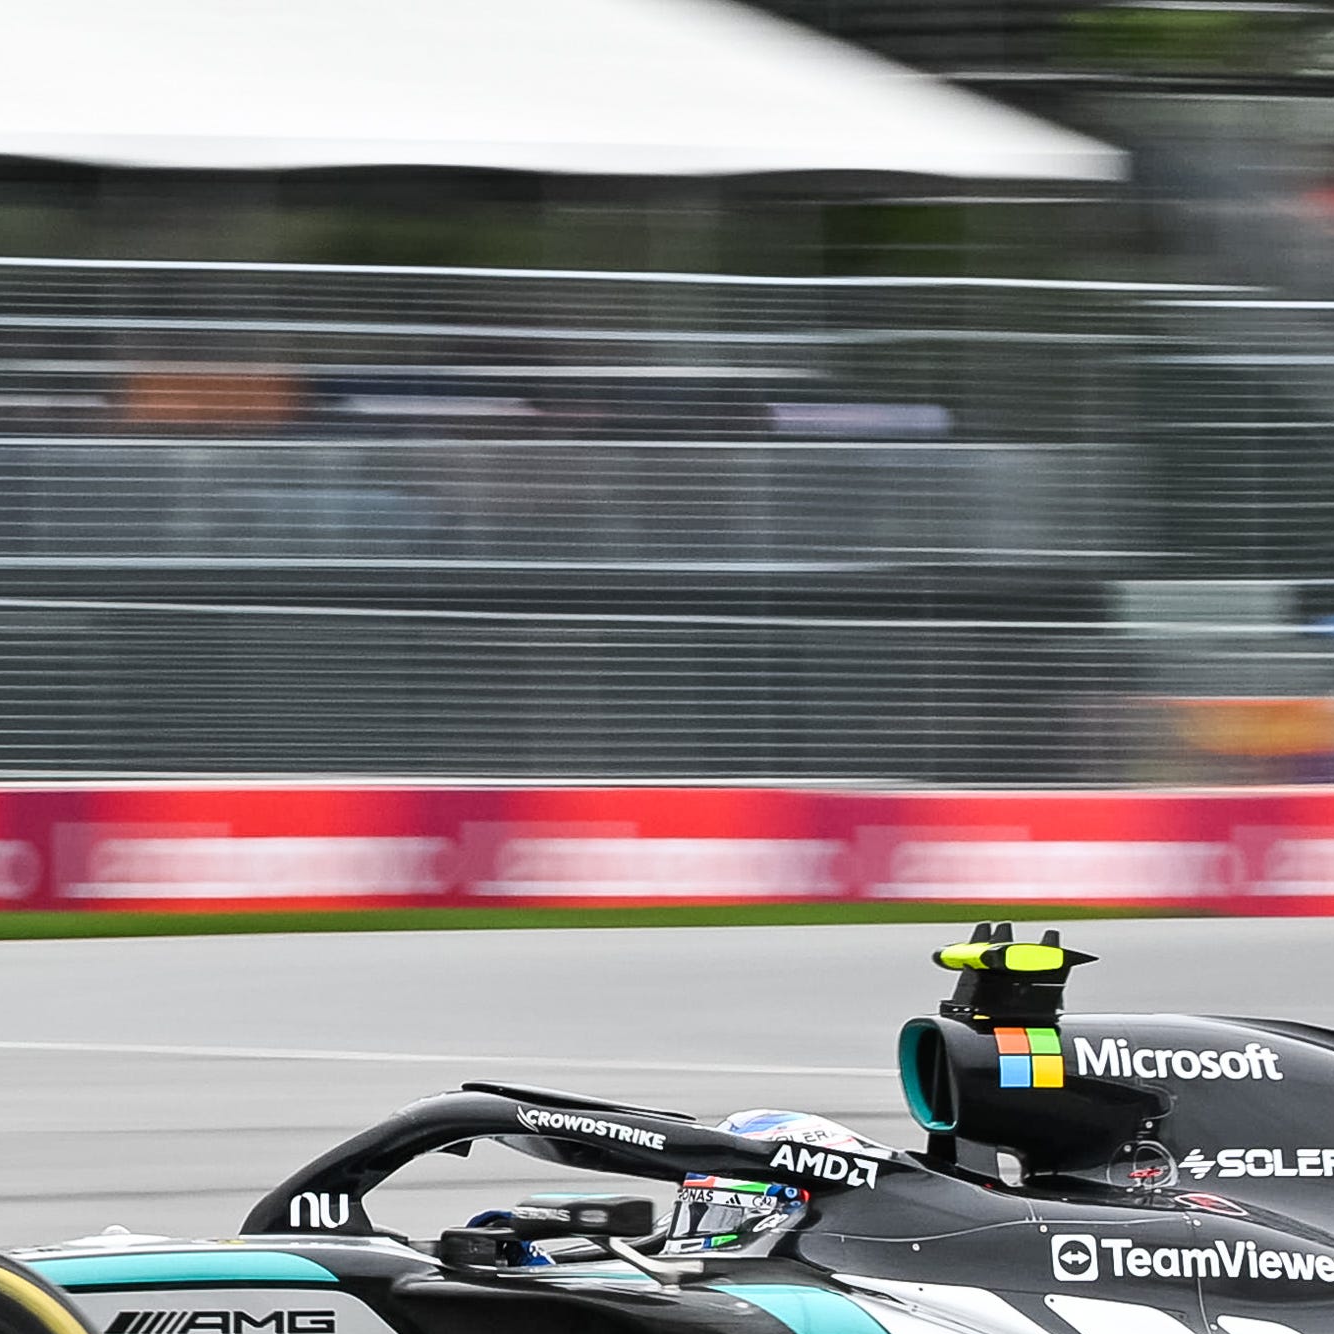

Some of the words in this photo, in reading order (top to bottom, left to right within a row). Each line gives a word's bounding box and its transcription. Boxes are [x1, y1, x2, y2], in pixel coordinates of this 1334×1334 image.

[1073, 1036, 1284, 1081] Microsoft
[526, 1109, 667, 1150] CROWDSTRIKE
[770, 1144, 849, 1181] AMD
[179, 1310, 335, 1334] AMG
